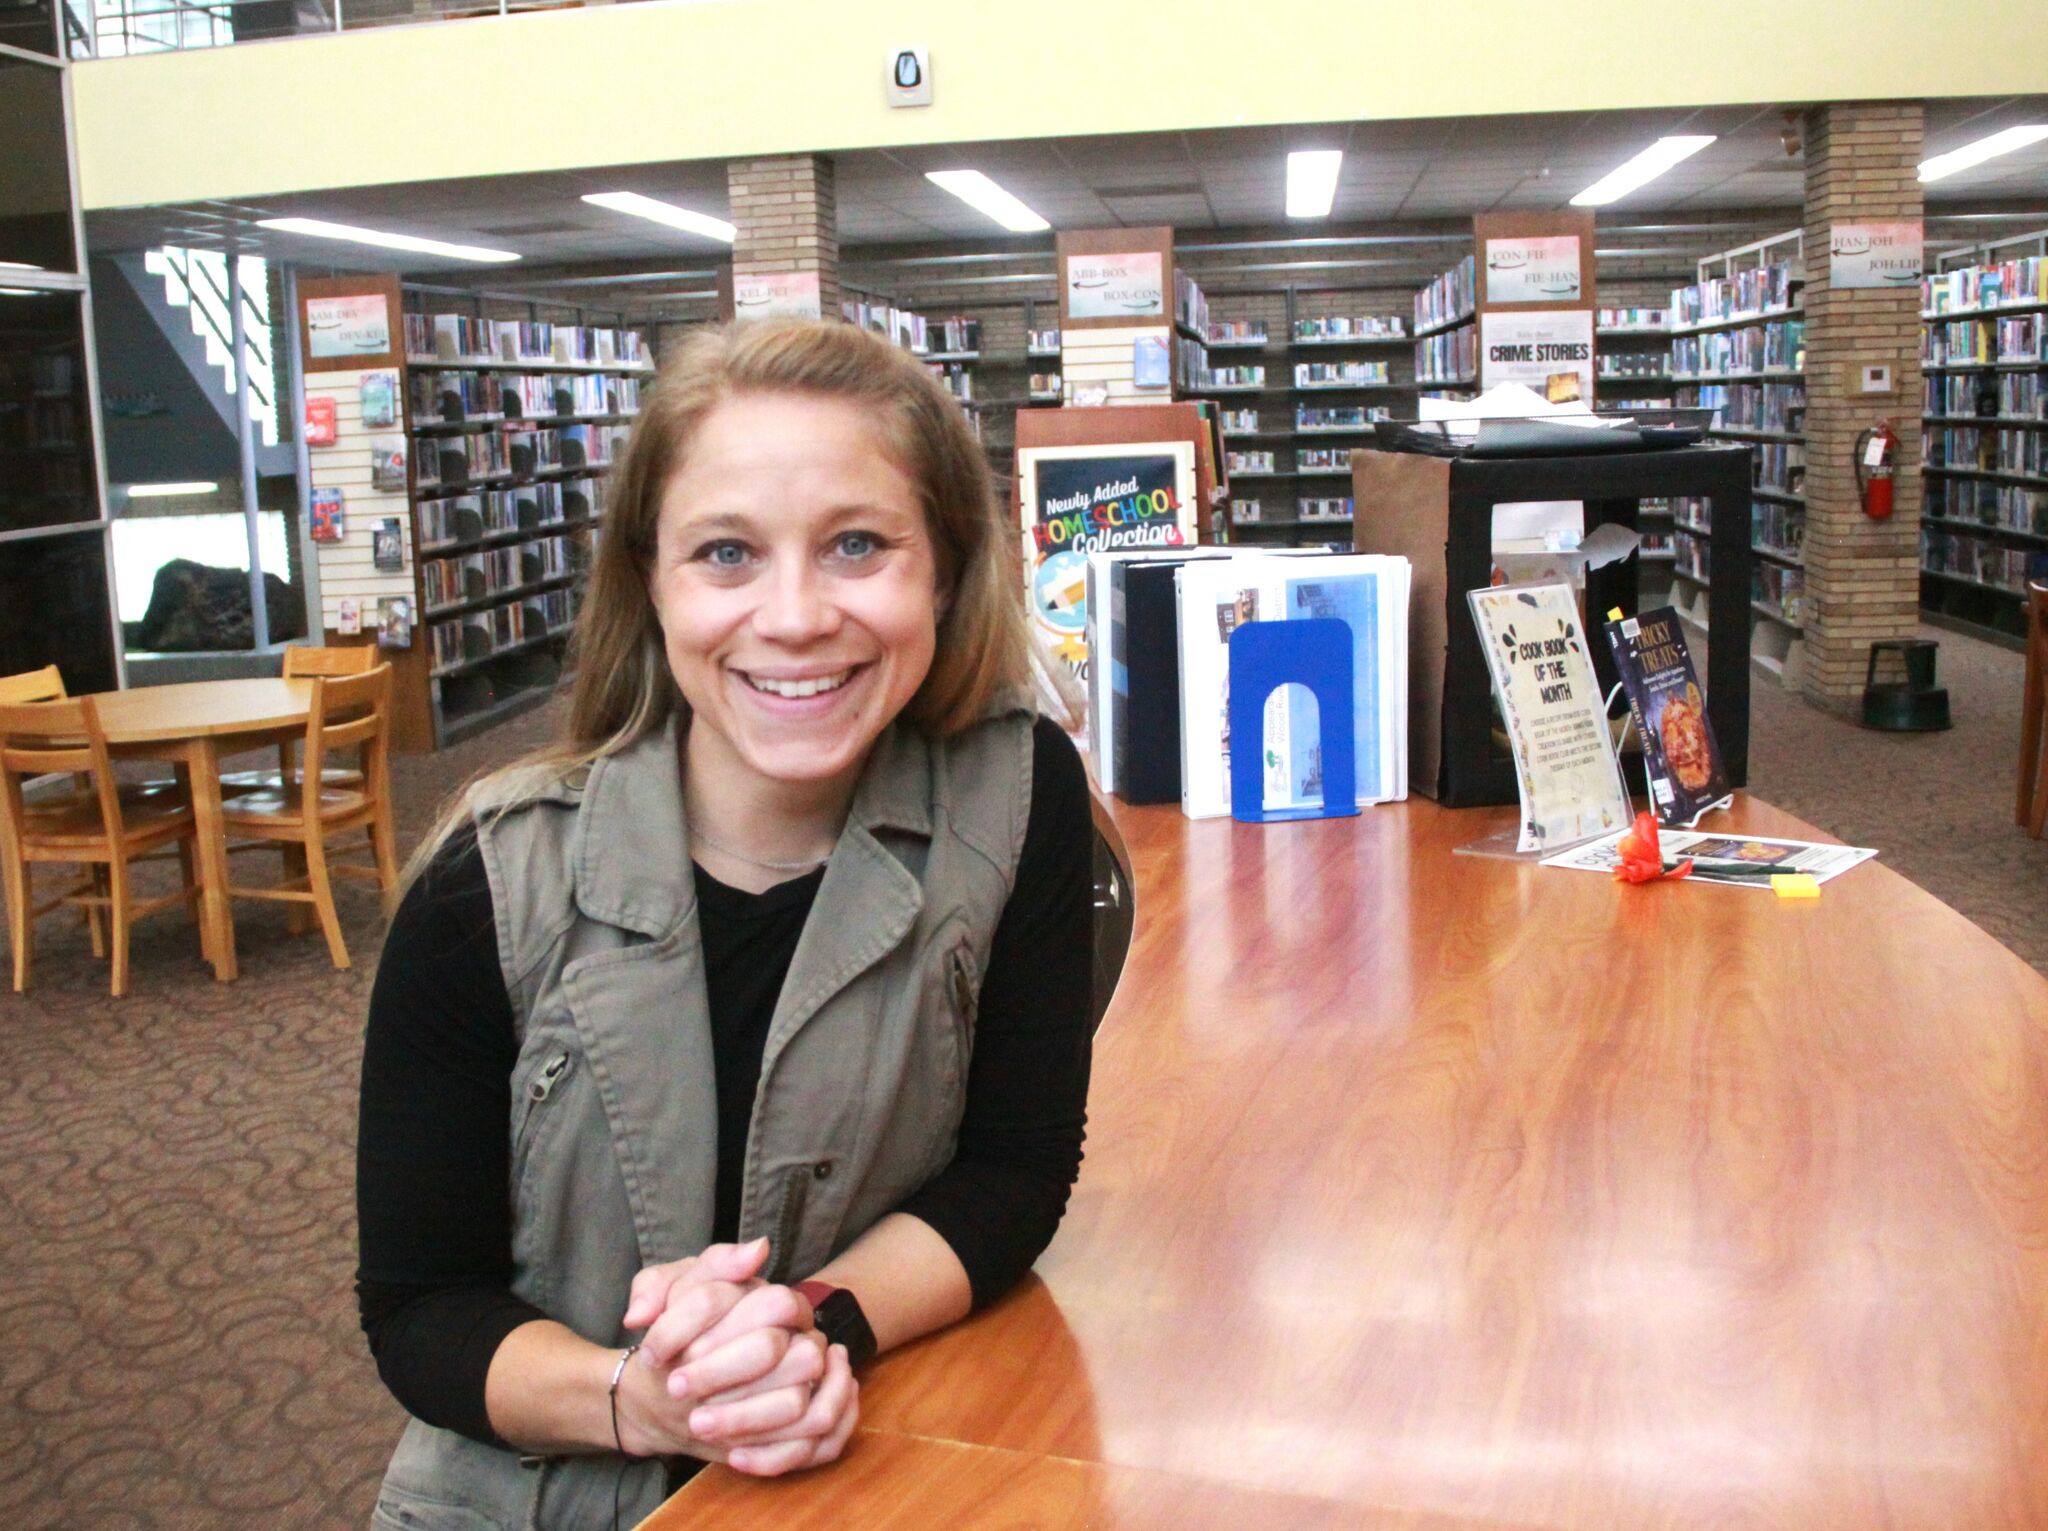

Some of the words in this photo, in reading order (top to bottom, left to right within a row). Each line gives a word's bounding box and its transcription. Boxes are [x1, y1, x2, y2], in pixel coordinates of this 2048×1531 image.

[1834, 237, 1893, 248] HAN-JOH
[1492, 250, 1545, 261] CON-FIE
[1869, 258, 1921, 272] JOH-LIP
[1073, 267, 1128, 279] ABB-BOX
[1524, 272, 1578, 284] FIE-HAN
[1103, 289, 1161, 301] BOX-CON
[1490, 344, 1533, 363] CRIME
[1536, 343, 1589, 362] STORIES
[1046, 491, 1090, 515] Newly
[1093, 475, 1139, 503] Added
[1032, 486, 1183, 548] HOMESCHOOL
[1072, 522, 1177, 555] Collection
[1636, 620, 1671, 650] TRICKY
[1520, 641, 1544, 660] COOK
[1544, 638, 1568, 656] BOOK
[1639, 643, 1679, 674] TREATS
[1534, 663, 1546, 682] OF
[1546, 660, 1567, 680] THE
[1540, 682, 1573, 705] MONTH
[1277, 713, 1287, 744] Wood
[1631, 697, 1642, 724] TRICKY
[1639, 727, 1652, 755] TREATS
